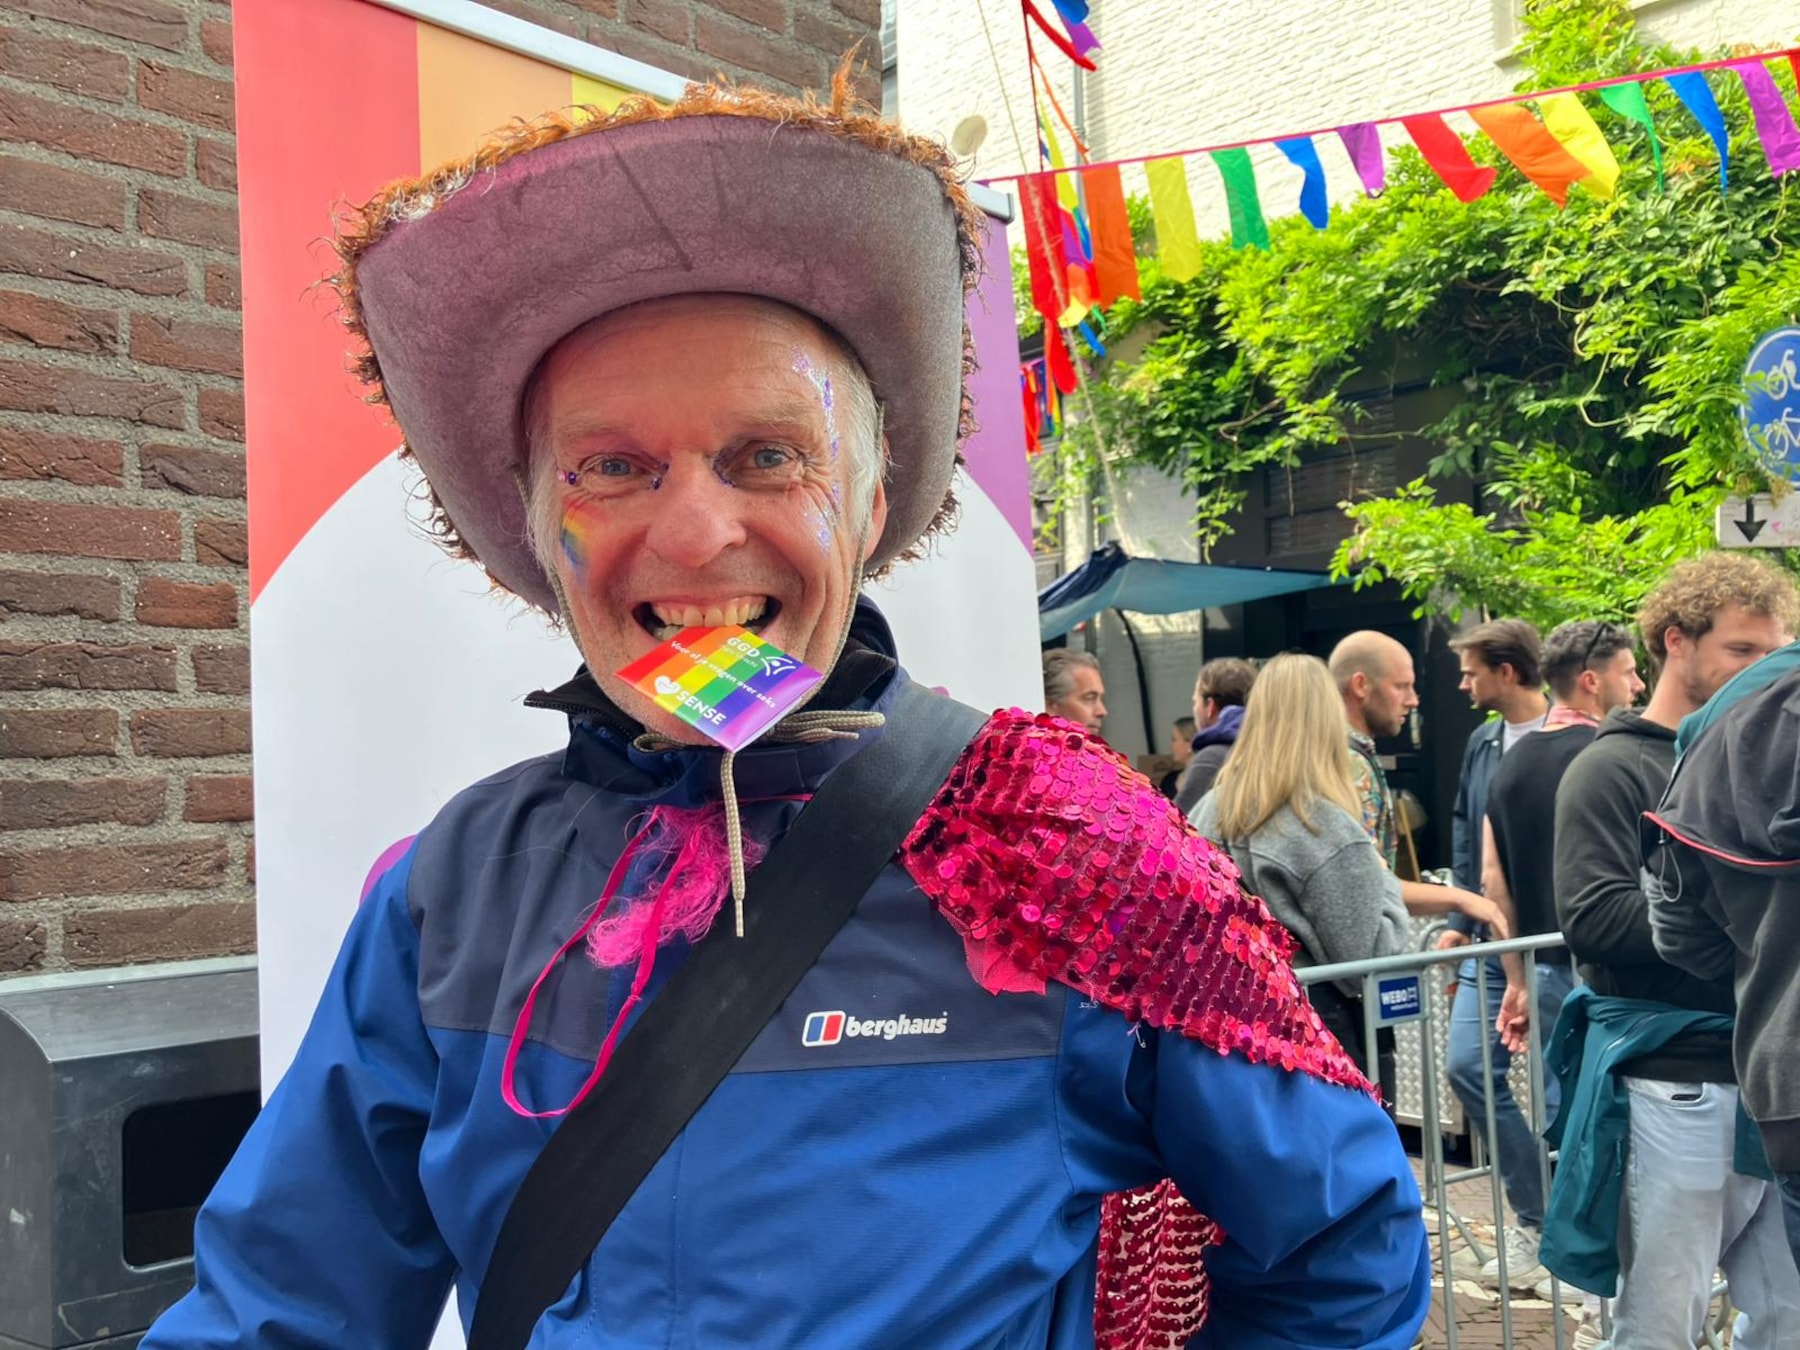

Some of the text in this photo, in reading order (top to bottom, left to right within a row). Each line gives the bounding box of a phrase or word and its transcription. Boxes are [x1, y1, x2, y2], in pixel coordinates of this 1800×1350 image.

[727, 637, 760, 657] GGD
[671, 640, 690, 654] Voor
[737, 681, 757, 694] over
[756, 693, 776, 708] seks
[676, 690, 726, 725] SENSE
[845, 1013, 947, 1040] berghaus
